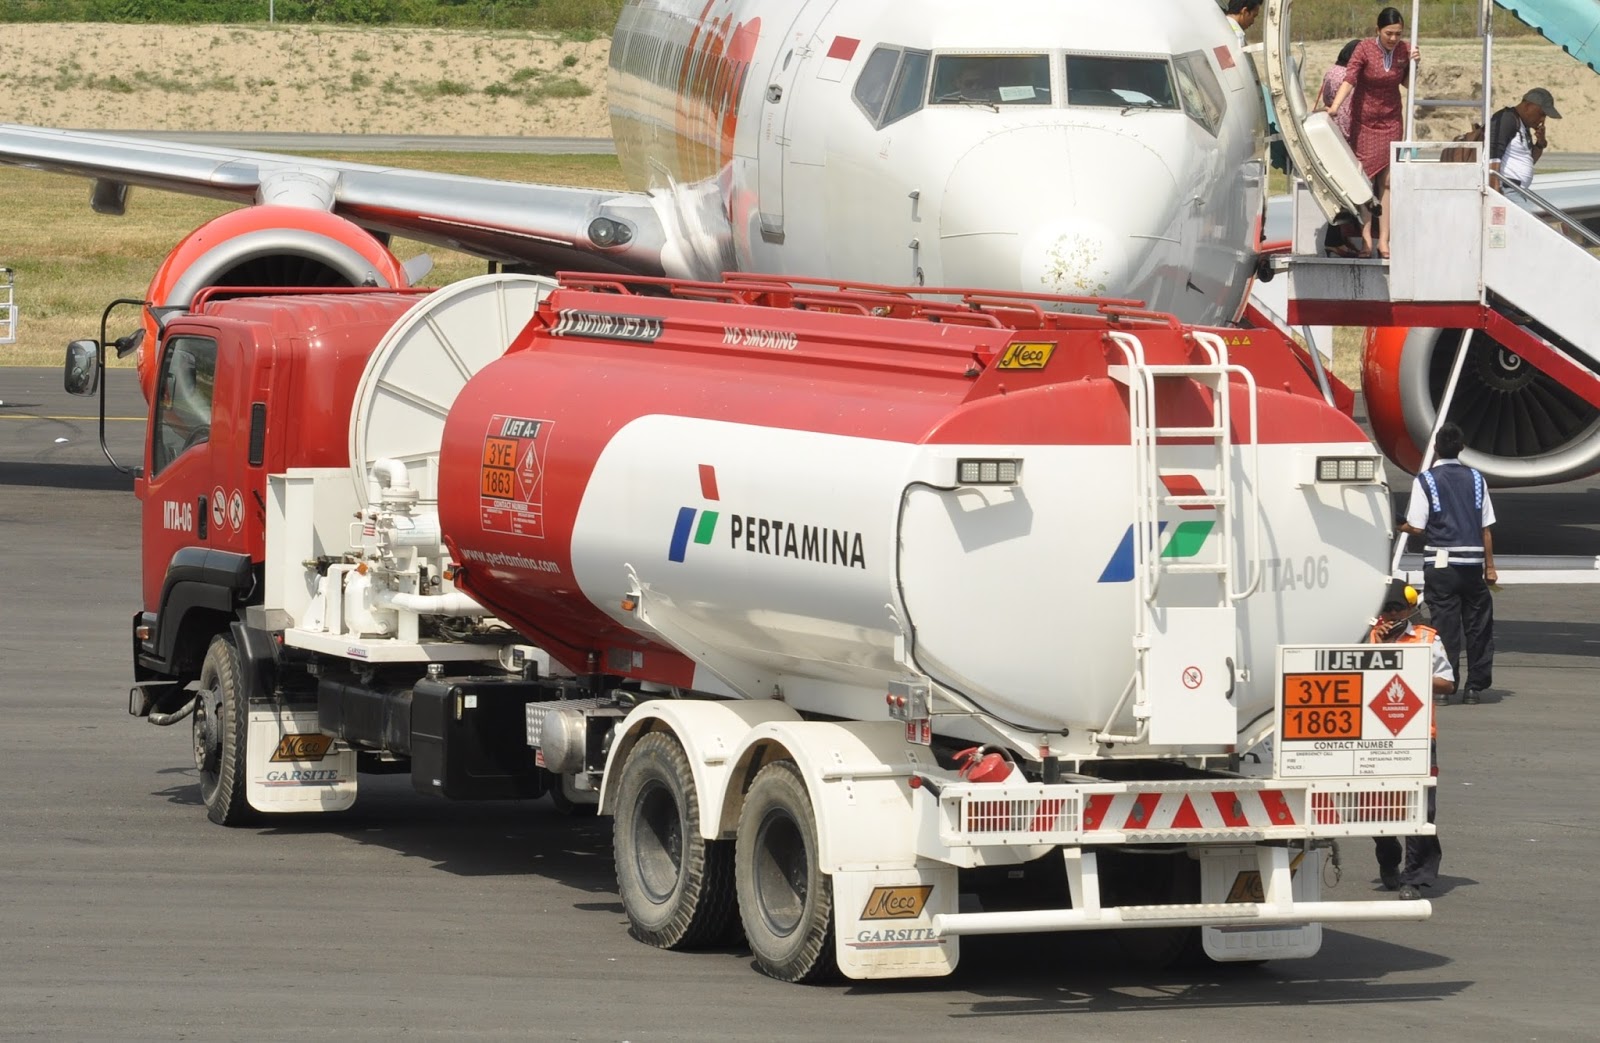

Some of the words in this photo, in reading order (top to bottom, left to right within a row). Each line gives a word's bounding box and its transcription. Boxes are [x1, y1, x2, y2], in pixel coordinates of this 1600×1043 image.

[574, 313, 613, 335] AVTUR
[617, 317, 640, 337] JET
[722, 326, 743, 345] NO
[742, 328, 798, 351] SMOKING
[1002, 345, 1044, 367] Meco
[506, 420, 525, 436] JET
[522, 421, 541, 438] A-1
[489, 443, 512, 466] 3YE
[486, 470, 511, 494] 1863
[163, 500, 192, 532] MTA-06
[731, 513, 866, 570] PERTAMINA
[460, 548, 561, 574] www.pertamina.com
[1331, 651, 1364, 669] JET
[1369, 651, 1403, 669] A-1
[1298, 680, 1350, 704] 3YE
[1292, 710, 1353, 735] 1863
[1314, 741, 1354, 749] CONTACT
[1357, 740, 1394, 749] NUMBER
[266, 769, 338, 781] GARSITE
[868, 889, 916, 917] Meco
[857, 928, 937, 943] GARSITE
